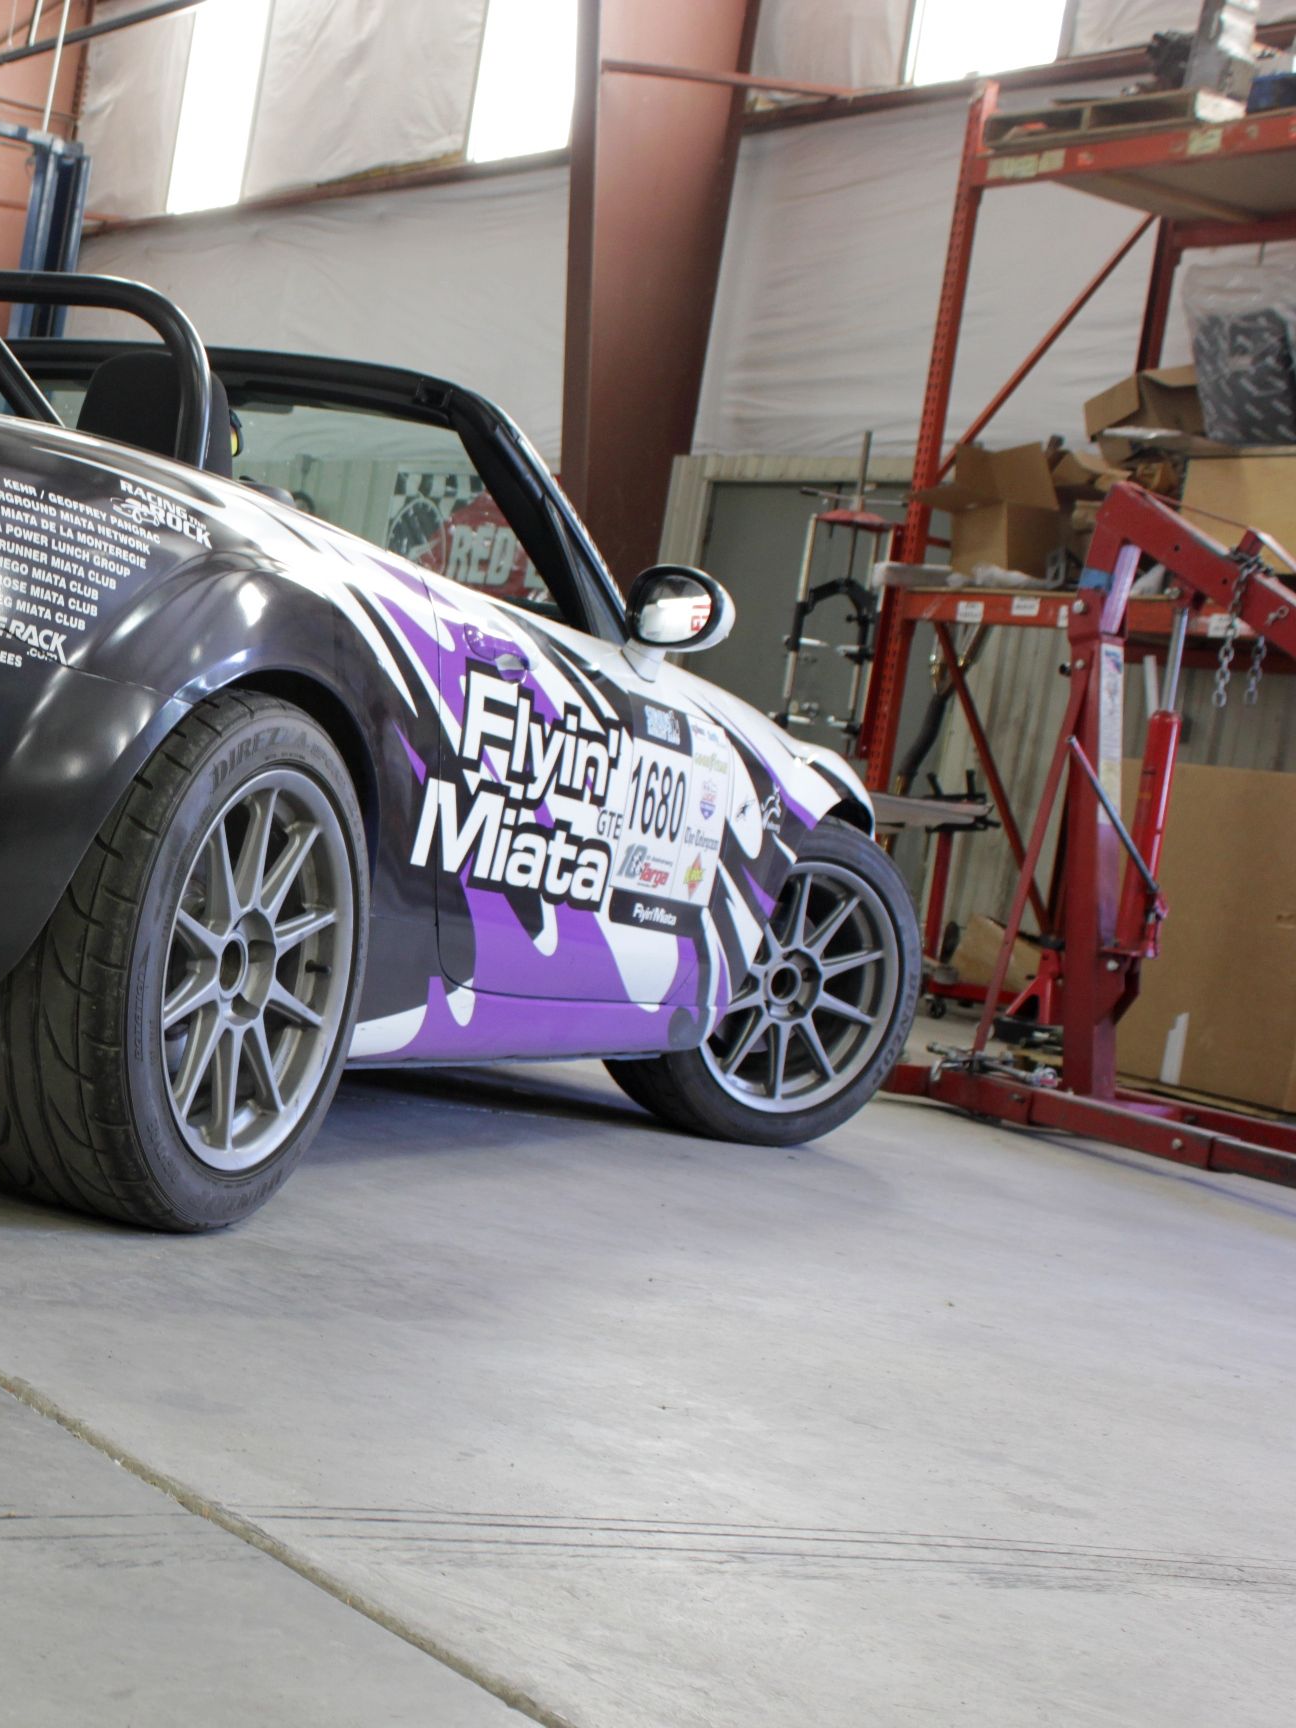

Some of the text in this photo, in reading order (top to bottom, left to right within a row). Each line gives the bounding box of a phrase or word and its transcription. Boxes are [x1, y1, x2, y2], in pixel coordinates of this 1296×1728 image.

[48, 492, 107, 521] GEOFFREY
[110, 515, 161, 545] PANGRAC
[119, 480, 188, 519] RACING
[1, 506, 38, 527] MIATA
[40, 519, 57, 534] DE
[59, 525, 74, 540] LA
[76, 531, 147, 569] MONTEREGIE
[60, 510, 95, 532] MIATA
[97, 523, 151, 555] NETWORK
[147, 505, 213, 550] ROCK
[5, 523, 49, 548] POWER
[51, 539, 90, 562] LUNCH
[93, 555, 131, 578] GROUP
[50, 555, 85, 578] MIATA
[87, 570, 117, 590] CLUB
[446, 523, 518, 586] RED
[30, 584, 65, 607] MIATA
[68, 598, 98, 617] CLUB
[31, 567, 67, 589] MIATA
[69, 580, 99, 600] CLUB
[15, 599, 52, 621] MIATA
[55, 612, 86, 631] CLUB
[462, 669, 620, 800] Flyin'
[628, 755, 687, 843] 1680
[409, 776, 609, 902] Miata
[596, 809, 624, 840] GTE
[639, 861, 670, 888] Targa
